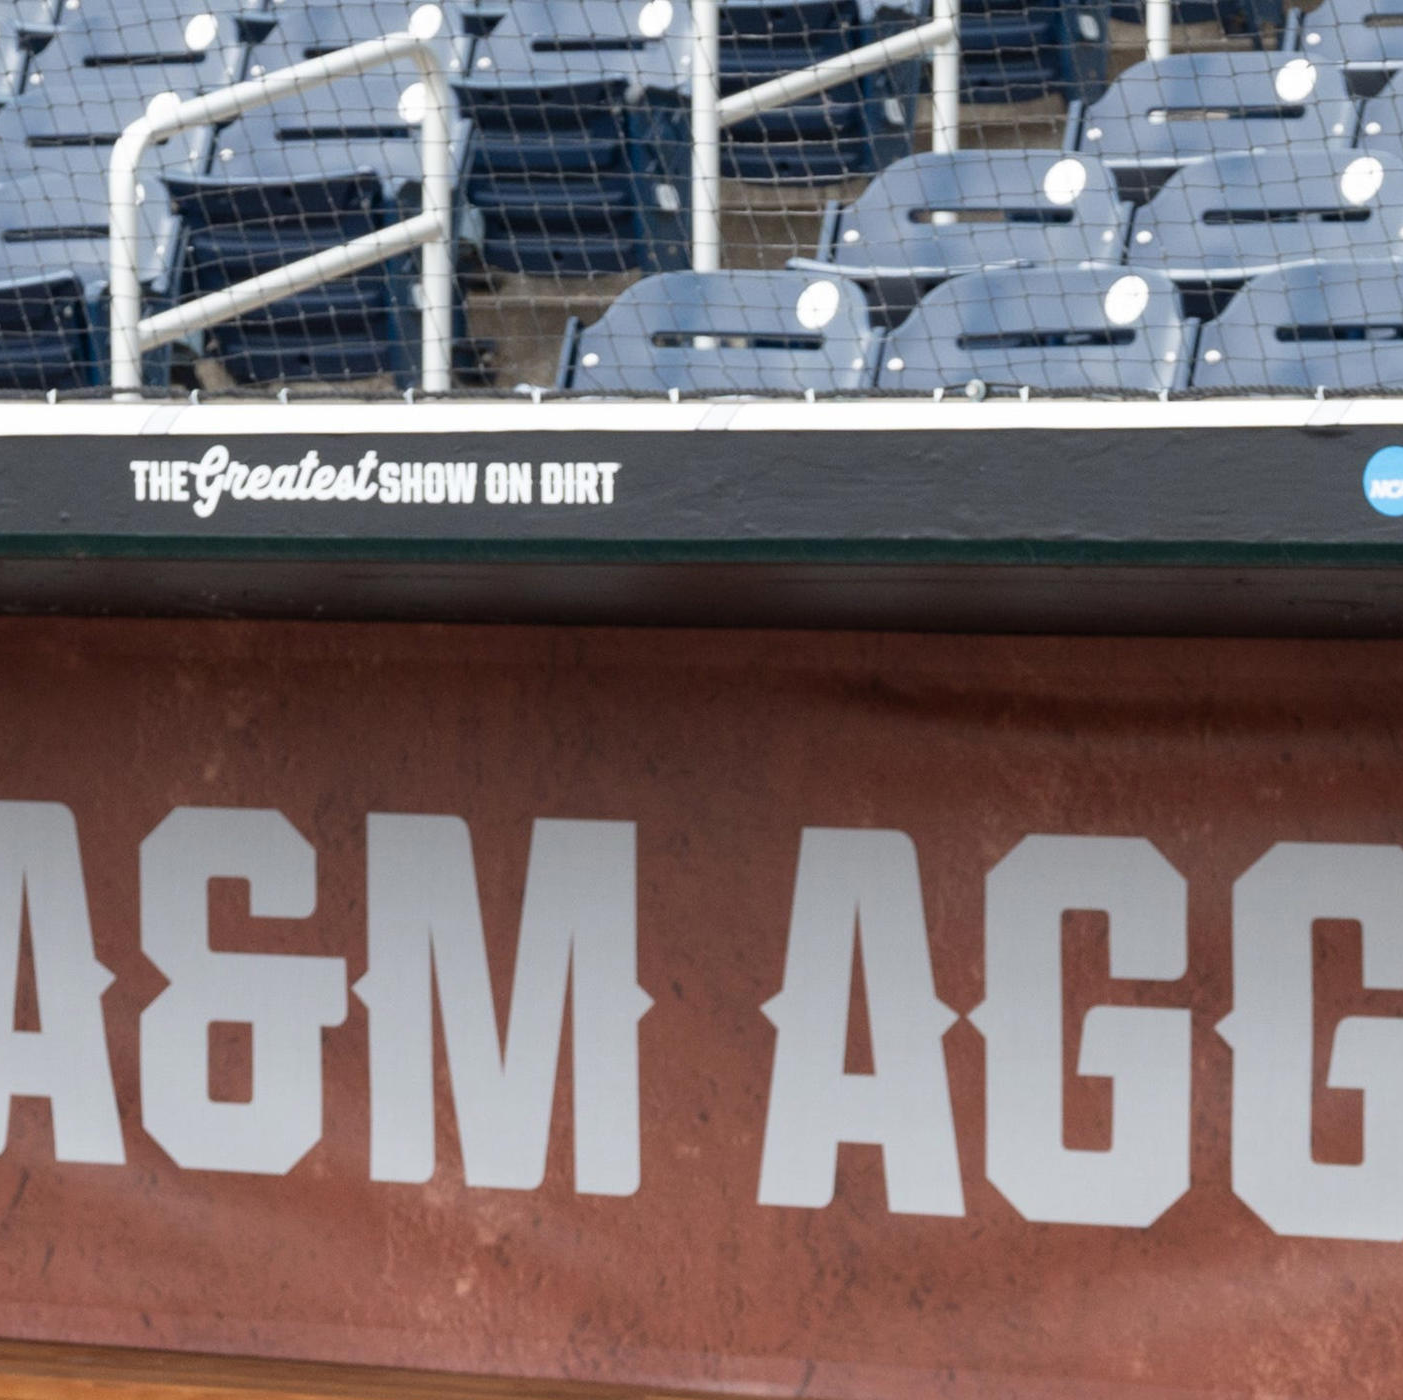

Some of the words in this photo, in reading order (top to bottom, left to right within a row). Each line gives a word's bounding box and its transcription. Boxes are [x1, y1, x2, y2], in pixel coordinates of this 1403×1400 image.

[129, 460, 191, 502] THE
[189, 444, 379, 518] Greatest
[378, 461, 478, 504] SHOW
[485, 462, 533, 504] ON
[540, 461, 620, 504] DIRT
